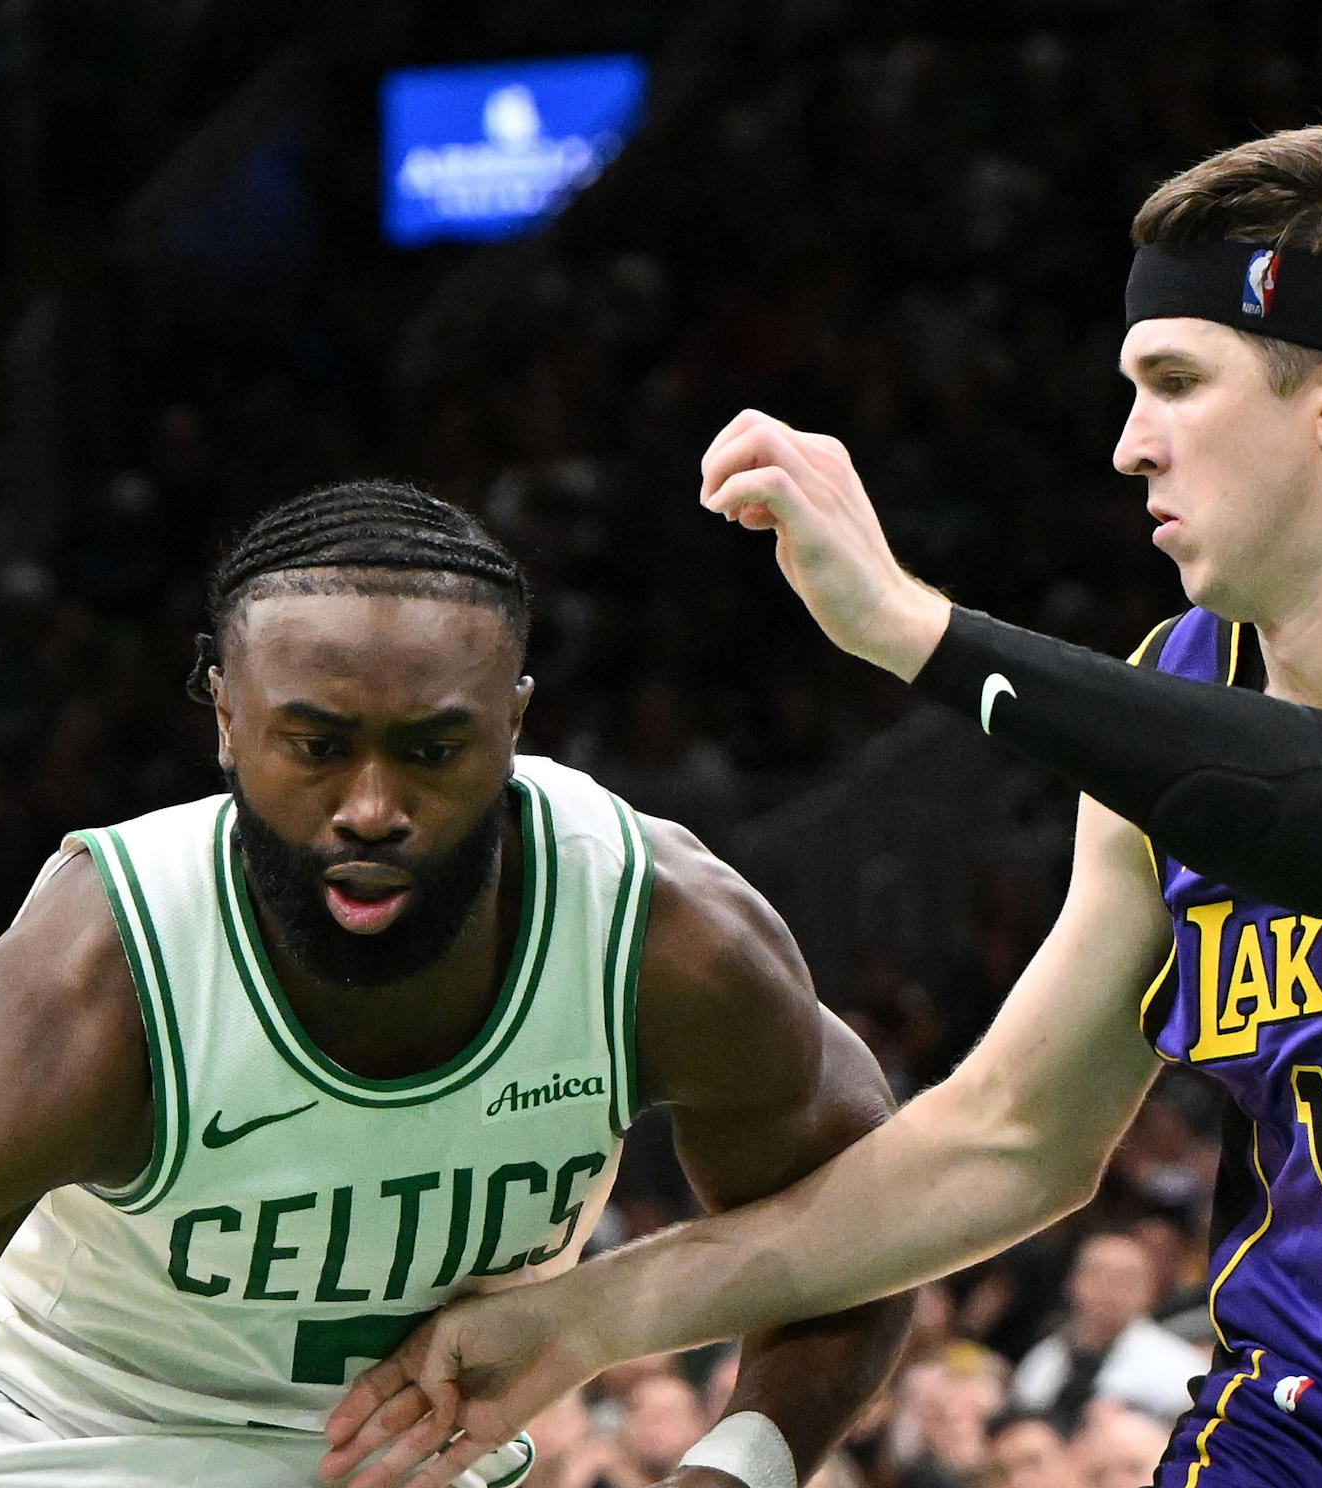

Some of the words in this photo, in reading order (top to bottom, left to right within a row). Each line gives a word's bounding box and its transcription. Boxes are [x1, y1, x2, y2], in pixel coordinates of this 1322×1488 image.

[1242, 302, 1261, 315] NBA
[486, 1073, 606, 1117] Amica
[168, 1152, 606, 1301] CELTICS
